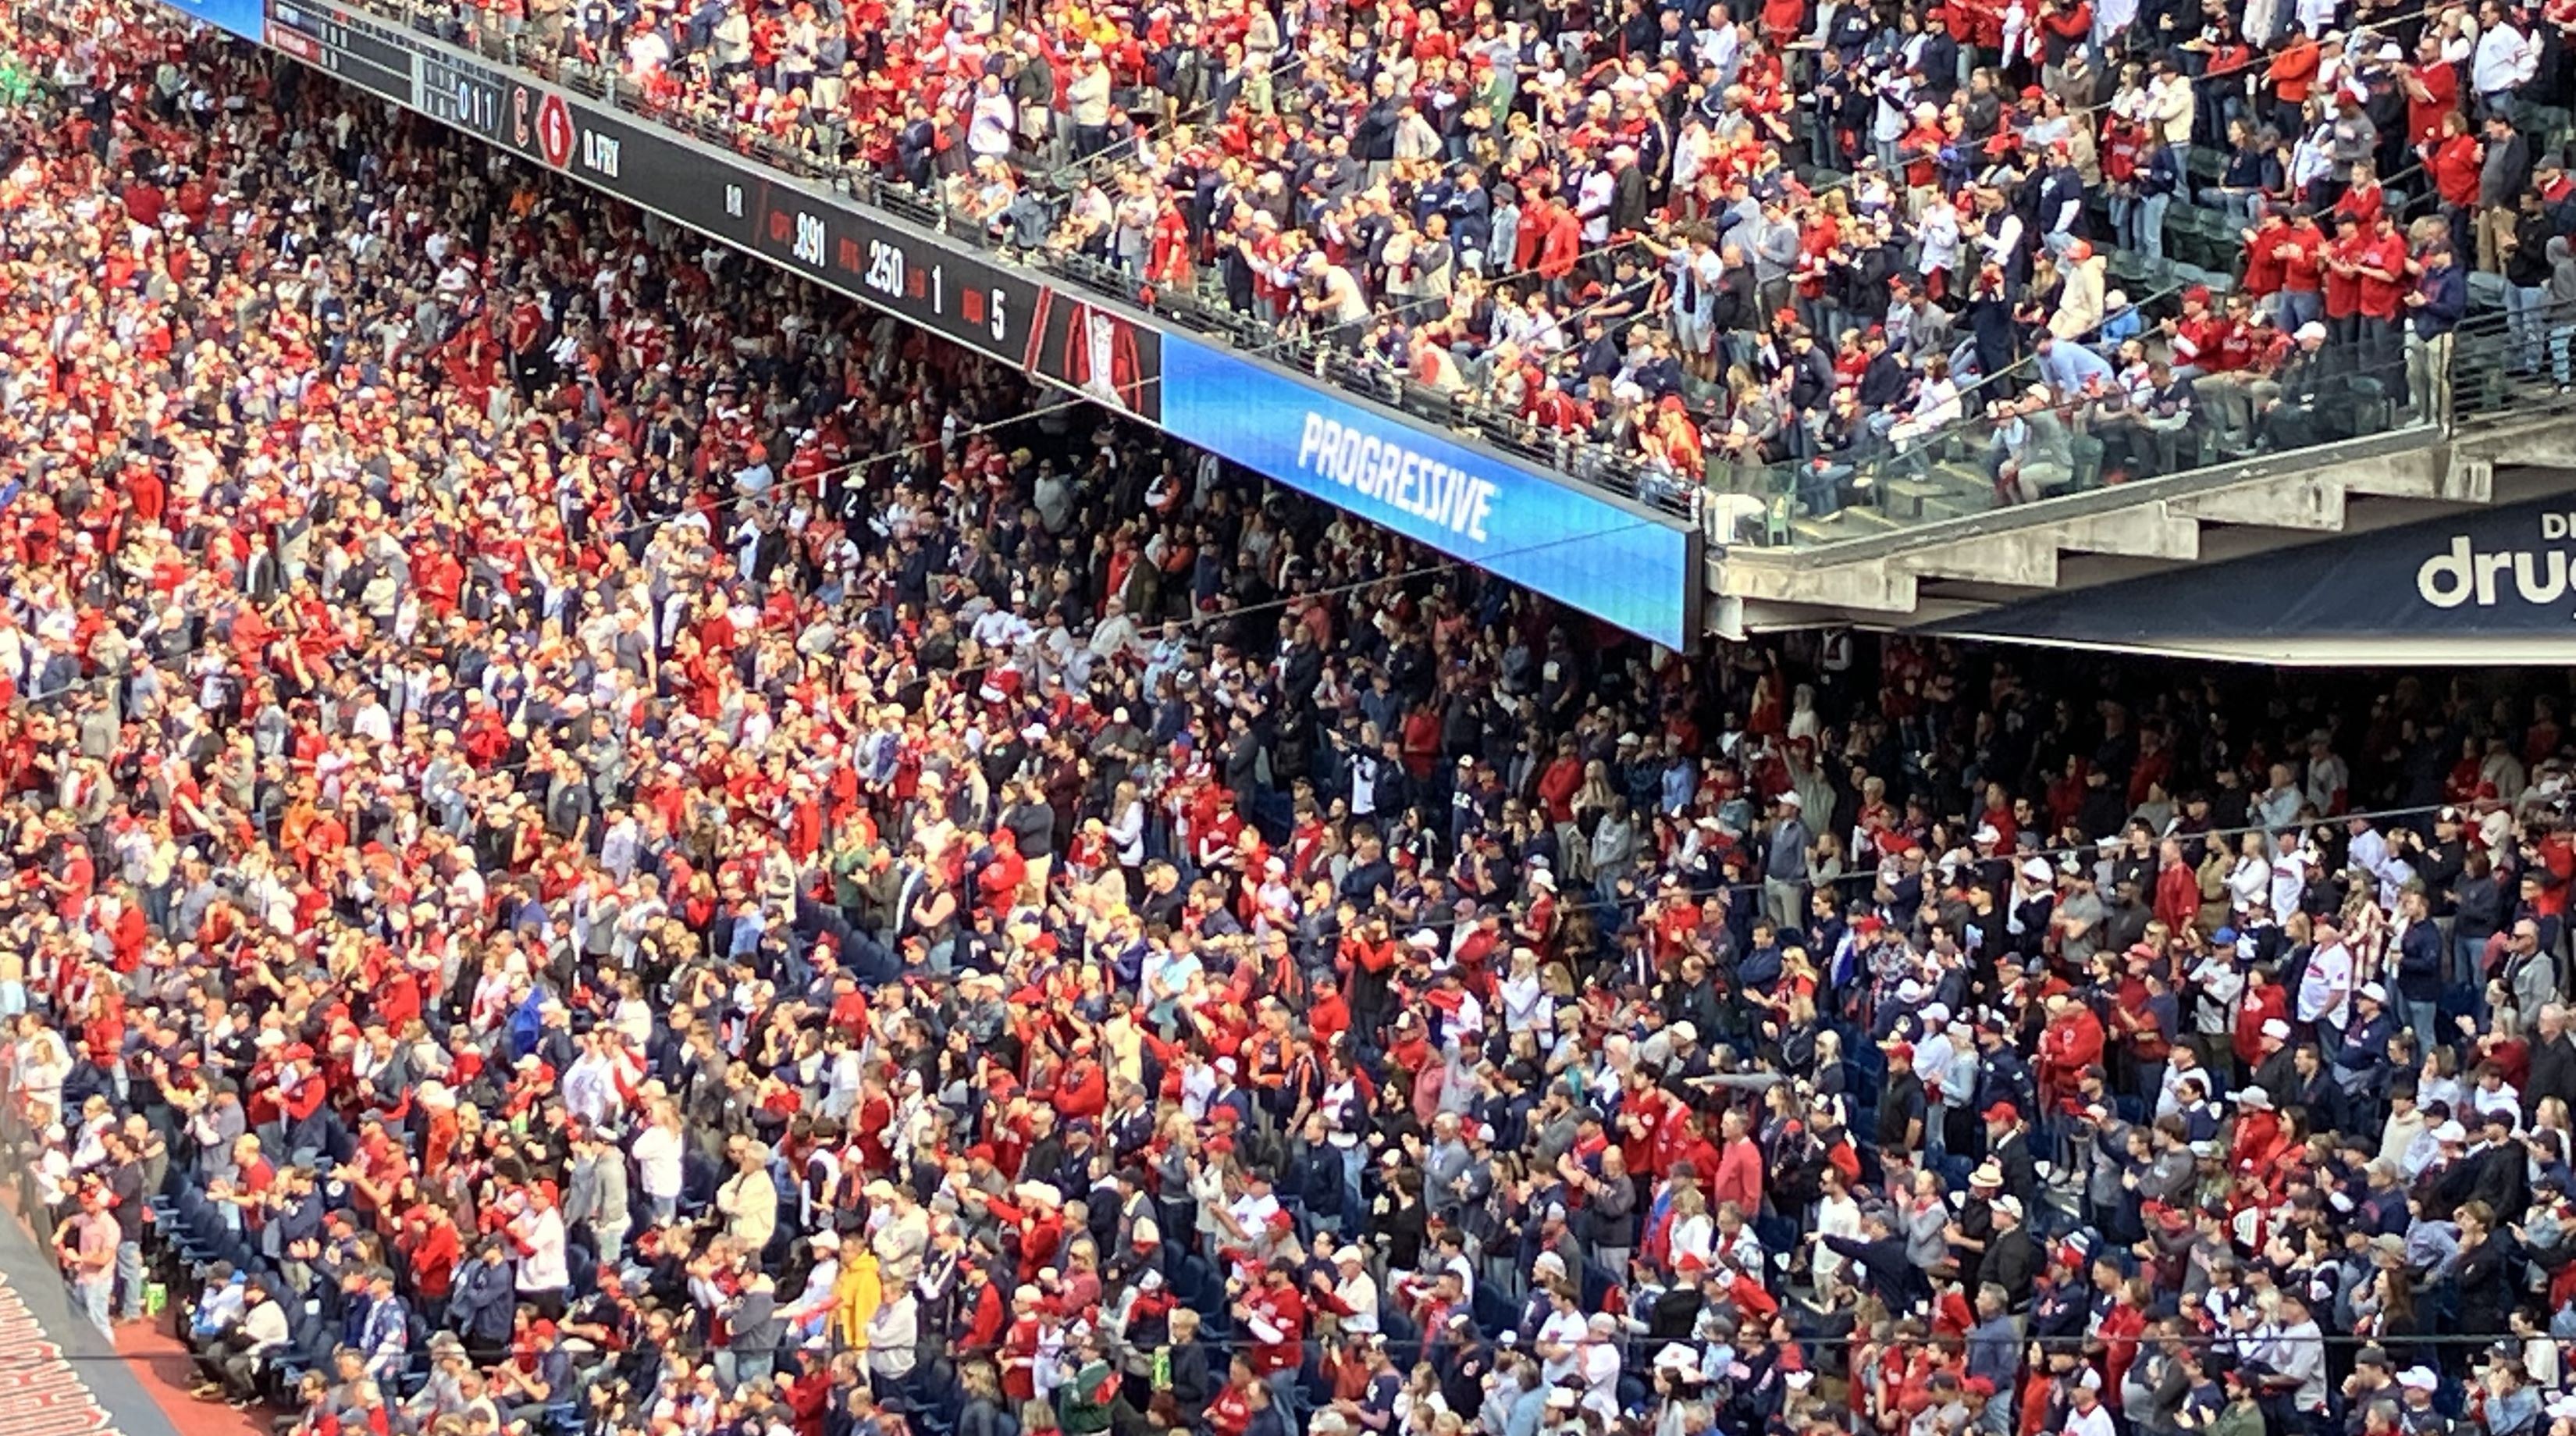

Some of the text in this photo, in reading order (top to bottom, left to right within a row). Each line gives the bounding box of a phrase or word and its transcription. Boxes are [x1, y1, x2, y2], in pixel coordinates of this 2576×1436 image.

[549, 109, 561, 156] 6
[793, 212, 825, 268] .891
[865, 239, 904, 298] .250
[931, 265, 941, 314] 1
[991, 288, 1005, 341] 5
[1297, 411, 1496, 543] PROGRESSIVE
[2417, 535, 2576, 608] dru
